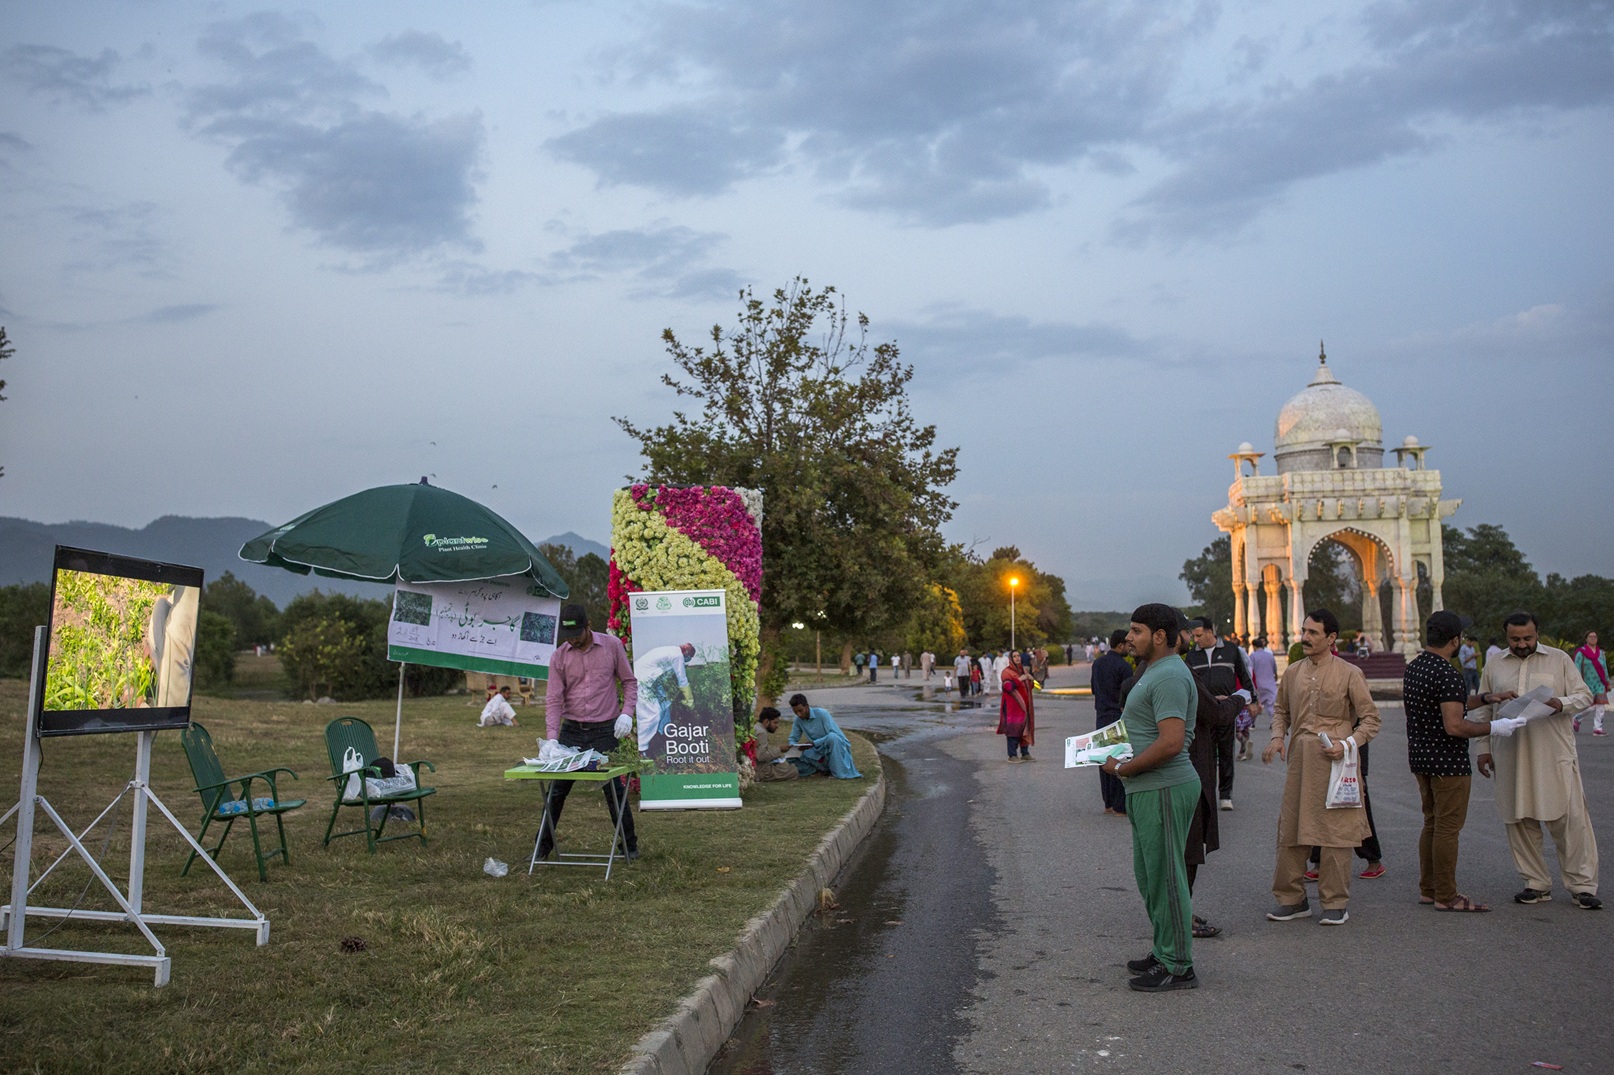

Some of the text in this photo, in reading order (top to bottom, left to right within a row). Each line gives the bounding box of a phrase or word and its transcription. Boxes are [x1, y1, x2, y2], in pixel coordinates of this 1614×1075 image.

[696, 598, 718, 606] CABI
[664, 723, 709, 741] Gajar
[666, 740, 709, 755] Booti
[666, 755, 710, 764] Root it out
